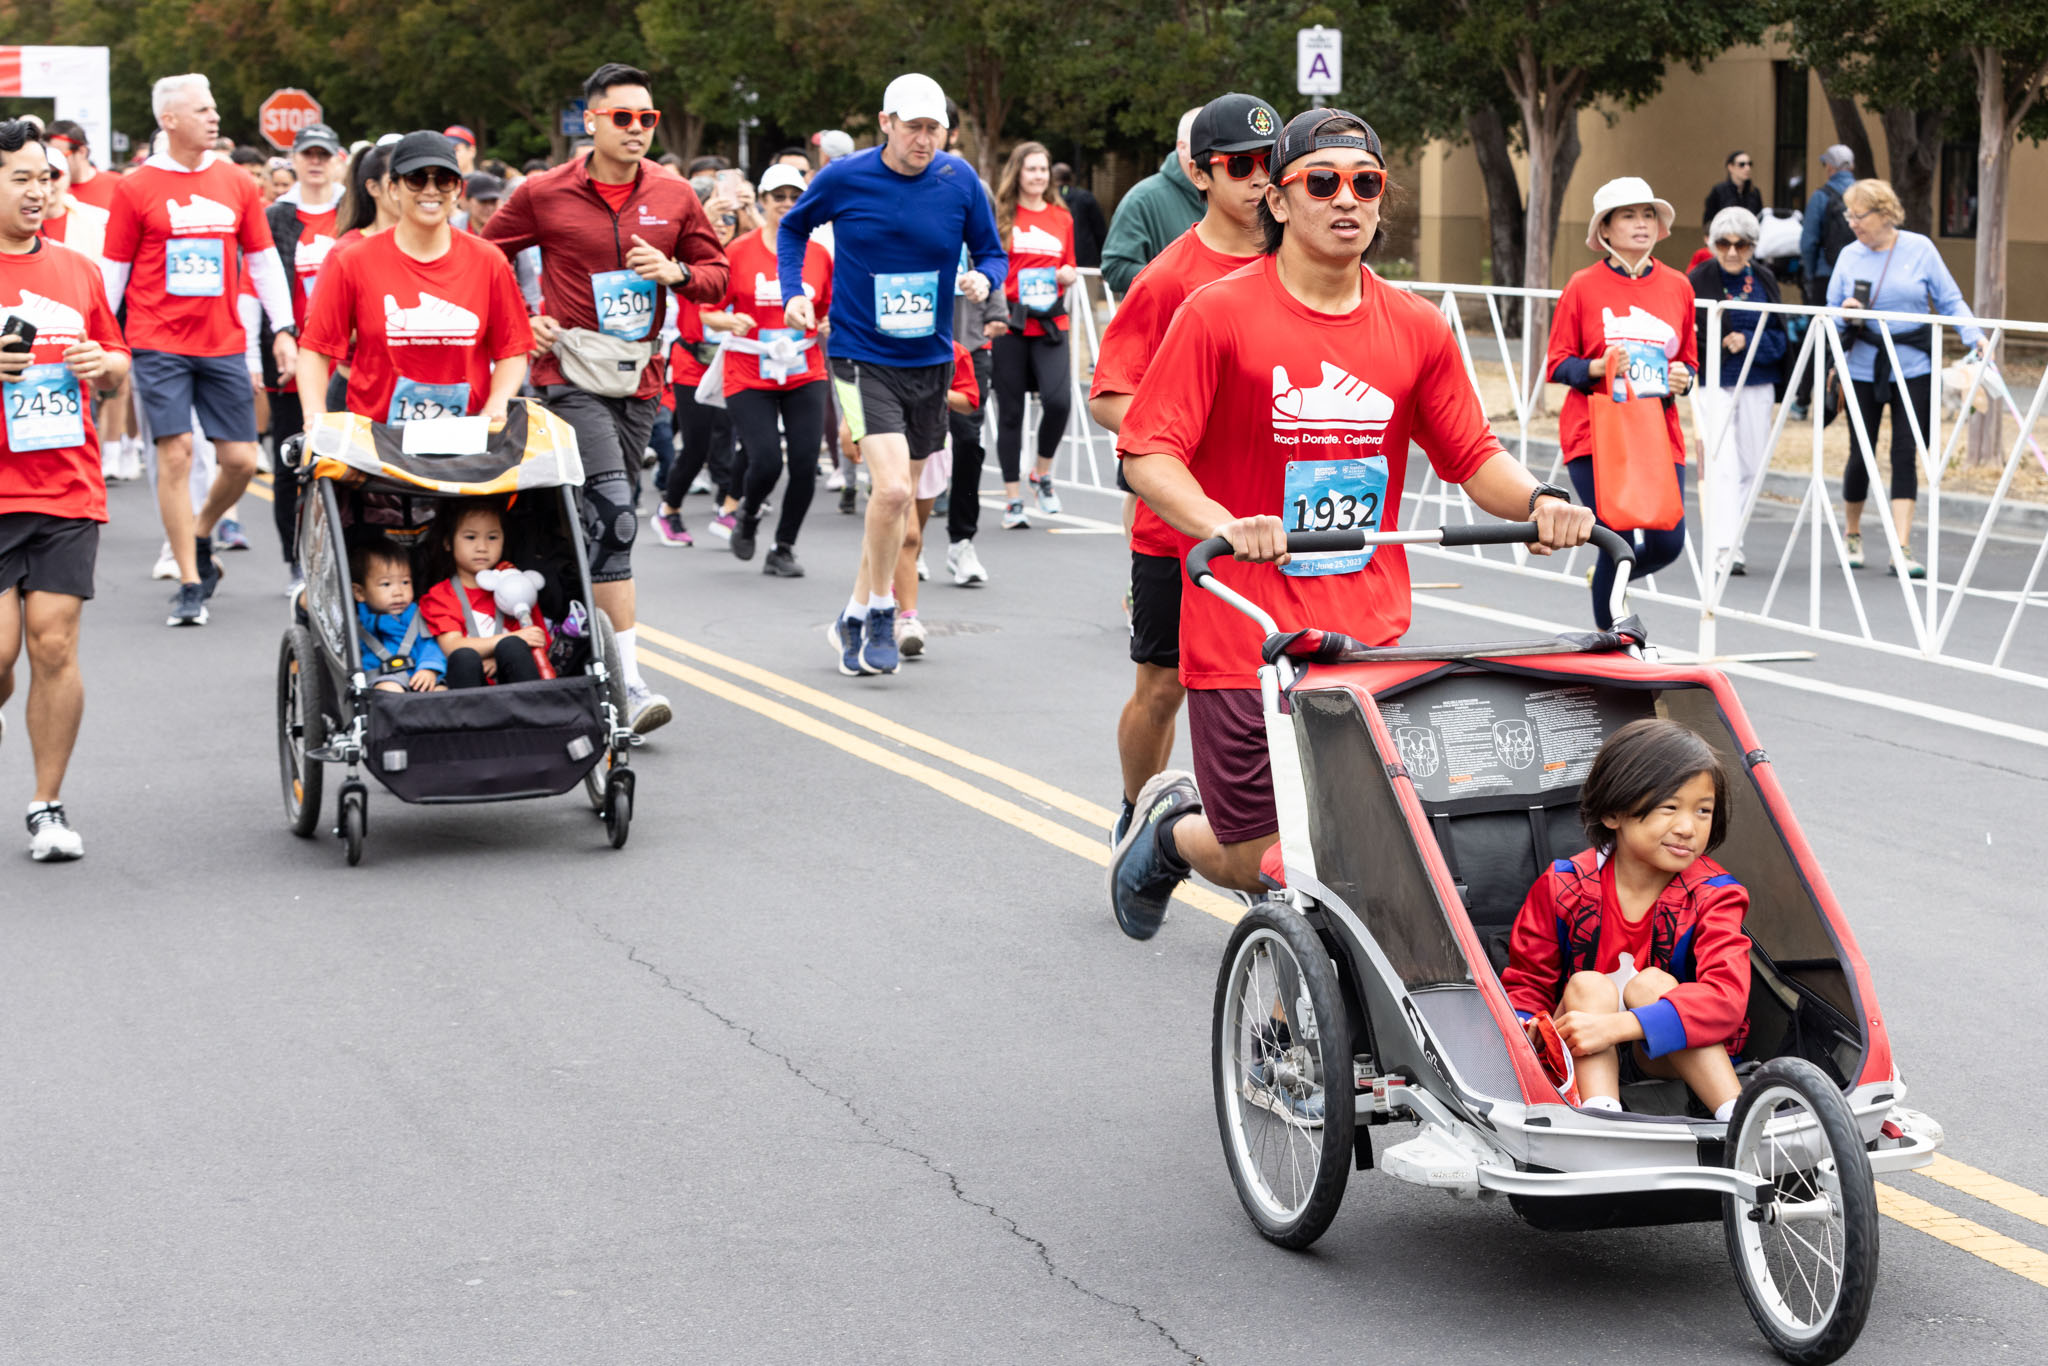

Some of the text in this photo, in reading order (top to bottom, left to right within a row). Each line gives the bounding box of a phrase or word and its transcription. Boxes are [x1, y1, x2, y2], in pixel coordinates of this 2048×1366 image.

[1308, 53, 1331, 79] A
[265, 108, 318, 132] STOP
[601, 290, 654, 318] 2501
[881, 292, 934, 315] 1252
[1629, 361, 1665, 385] 004
[9, 388, 80, 420] 2458
[1302, 433, 1342, 445] Donate.
[1290, 492, 1379, 533] 1932
[1347, 558, 1362, 567] 2023
